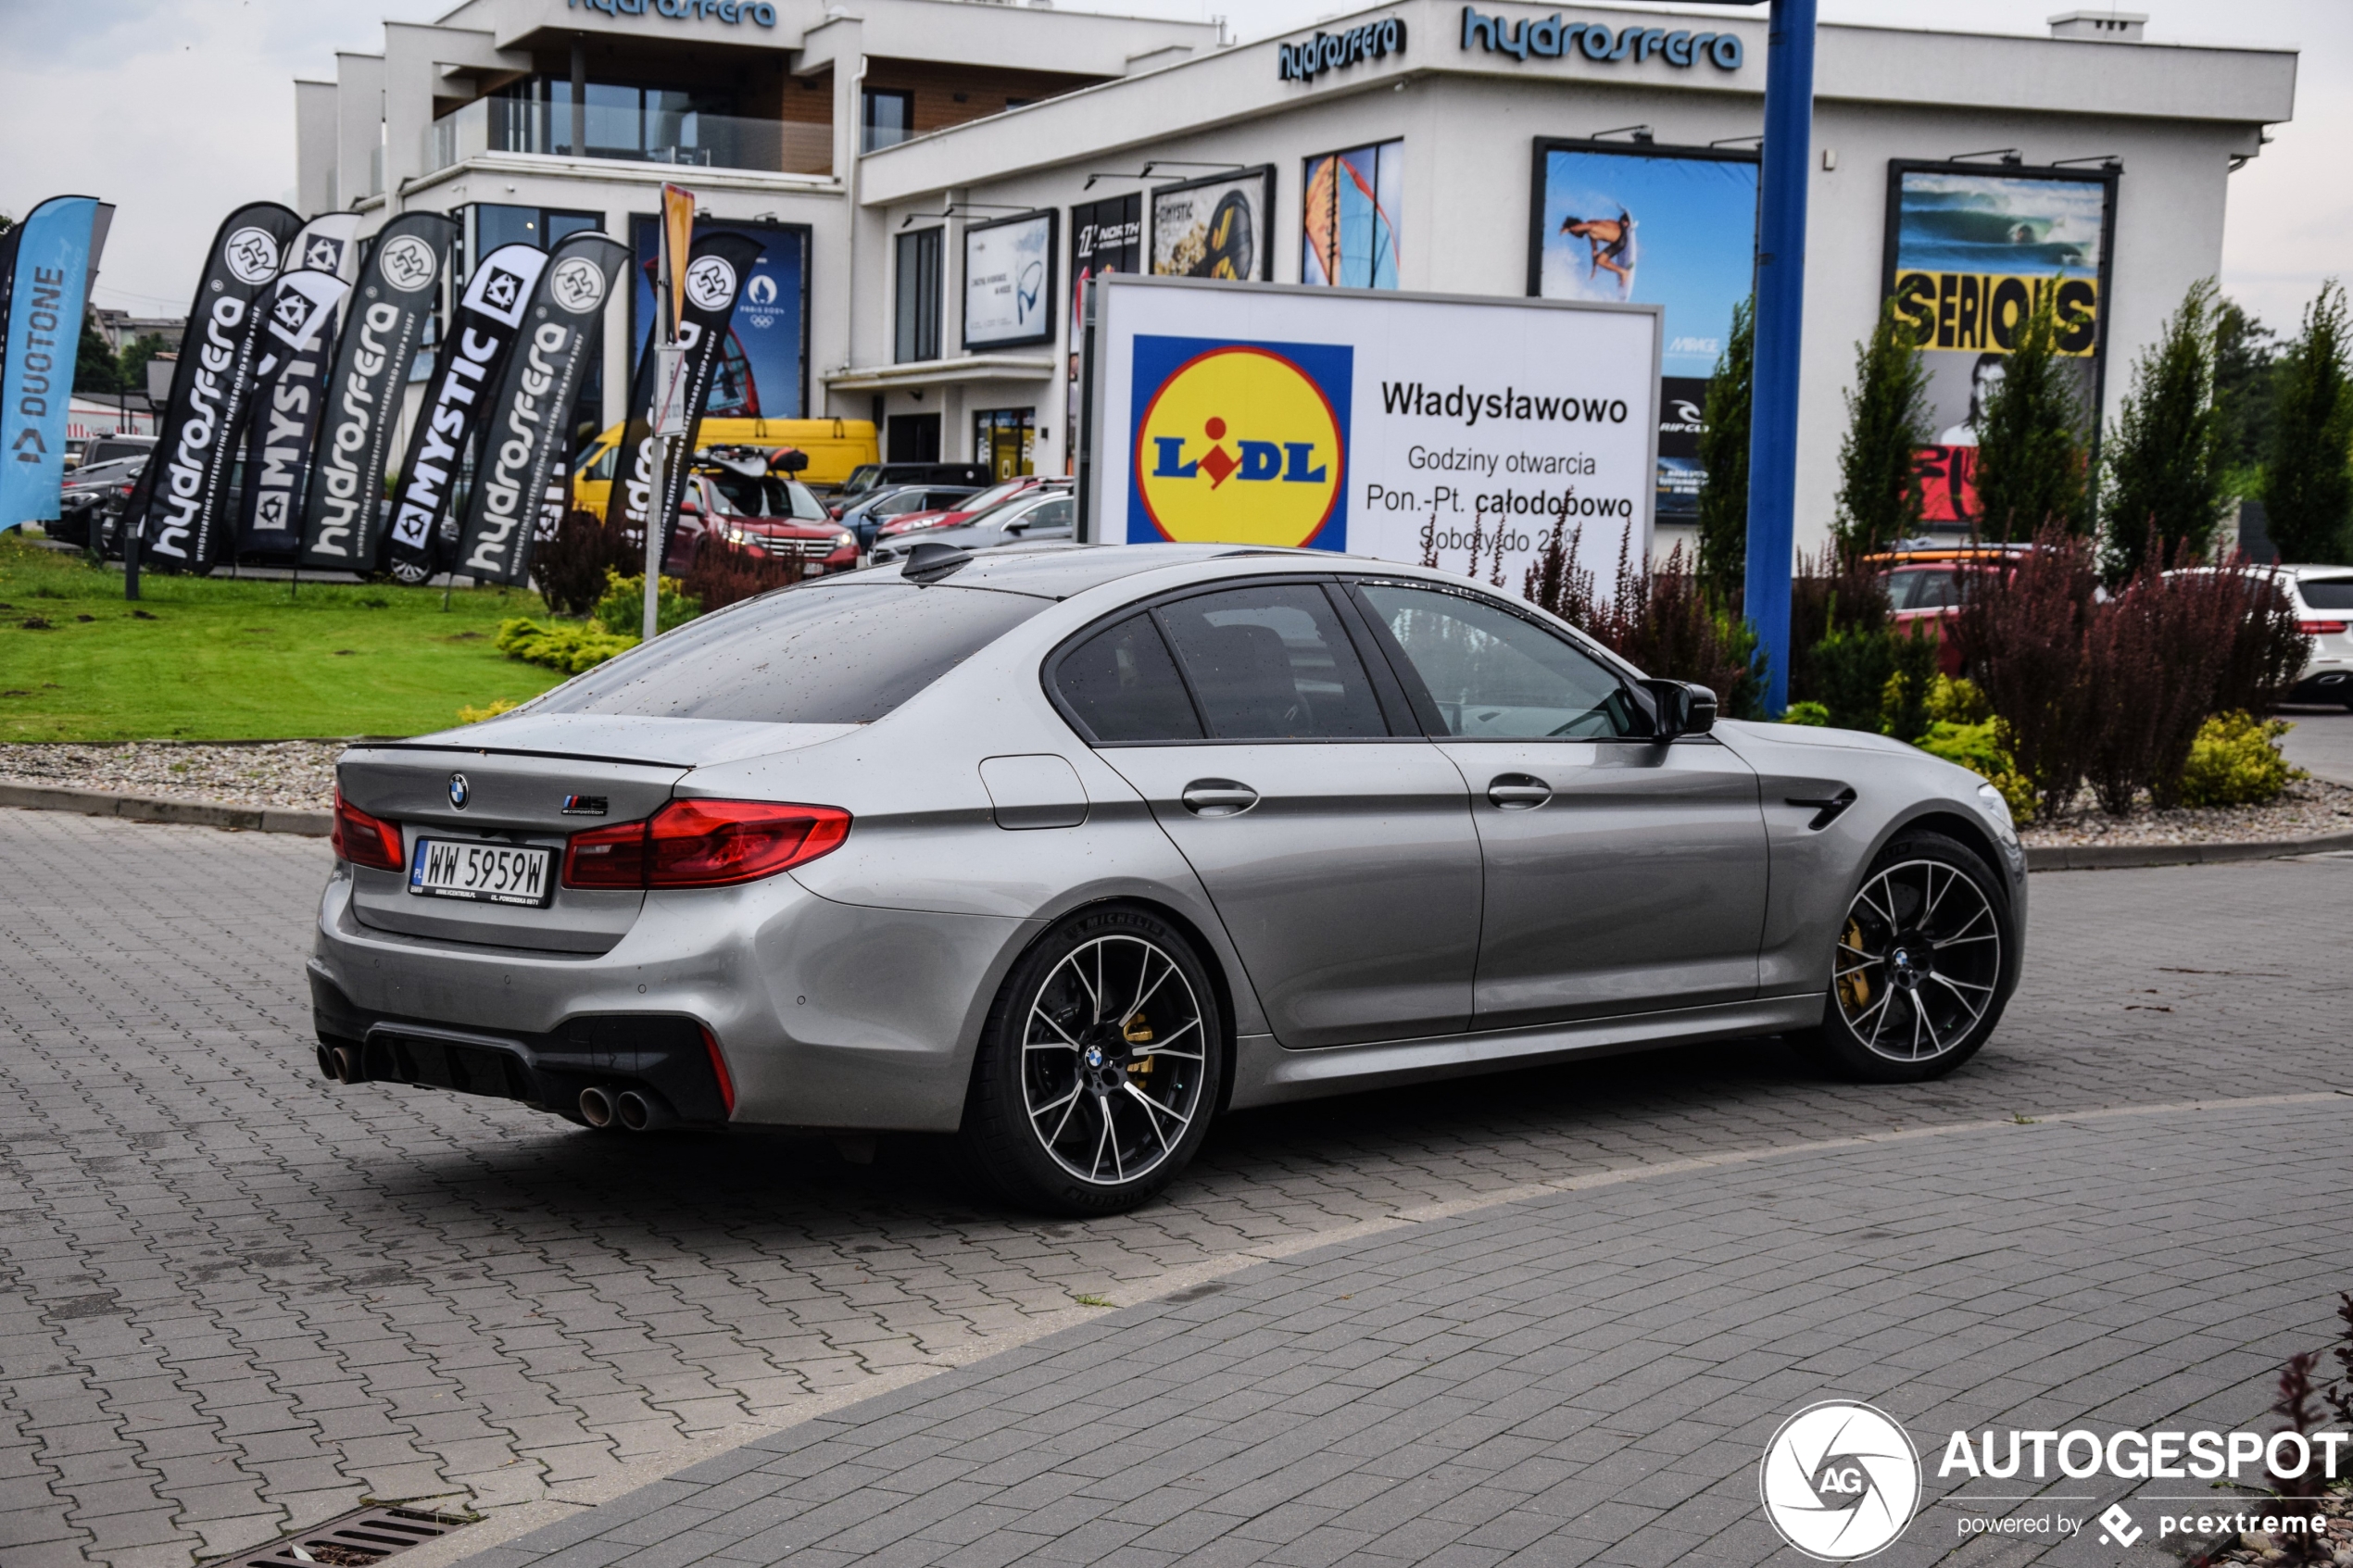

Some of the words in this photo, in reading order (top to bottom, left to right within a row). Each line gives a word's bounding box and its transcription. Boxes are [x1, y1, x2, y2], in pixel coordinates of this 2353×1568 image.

[568, 0, 776, 27] yrosfera
[1462, 6, 1743, 69] hydrosfera
[1278, 17, 1399, 82] hydrosfera
[1099, 221, 1140, 241] NORTH
[20, 266, 64, 417] DUOTONE
[152, 295, 245, 558] hydrosfera
[196, 497, 214, 561] WINDSURFING
[208, 429, 230, 490] KITESURFING
[225, 363, 248, 421] WAKEBOARD
[243, 337, 255, 356] SUP
[250, 306, 262, 330] SURF
[259, 336, 322, 486] MYSTI
[310, 302, 399, 557] hydrosfera
[366, 432, 383, 491] KITESURFING
[377, 368, 399, 425] WAKEBOARD
[396, 343, 407, 361] SUP
[403, 312, 415, 335] SURF
[405, 327, 499, 508] MYSTIC
[666, 446, 684, 504] KITESURFING
[679, 384, 701, 440] WAKEBOARD
[697, 359, 708, 377] SUP
[705, 330, 717, 353] SURF
[1381, 382, 1628, 426] Władysławowo
[465, 322, 568, 572] hydrosfera
[510, 515, 531, 576] WINDSURFING
[526, 450, 549, 507] KITESURFING
[544, 388, 566, 444] WAKEBOARD
[563, 363, 574, 382] SUP
[571, 332, 584, 356] SURF
[1408, 445, 1499, 478] Godziny
[1505, 451, 1596, 475] otwarcia
[1366, 483, 1466, 512] Pon.-Pt.
[1475, 488, 1633, 518] całodobowo
[1419, 525, 1496, 557] Soboty
[1503, 528, 1530, 553] do
[413, 868, 422, 879] PL
[427, 845, 460, 885] WW
[464, 847, 544, 894] 5959W
[1086, 912, 1162, 935] MICHELIN
